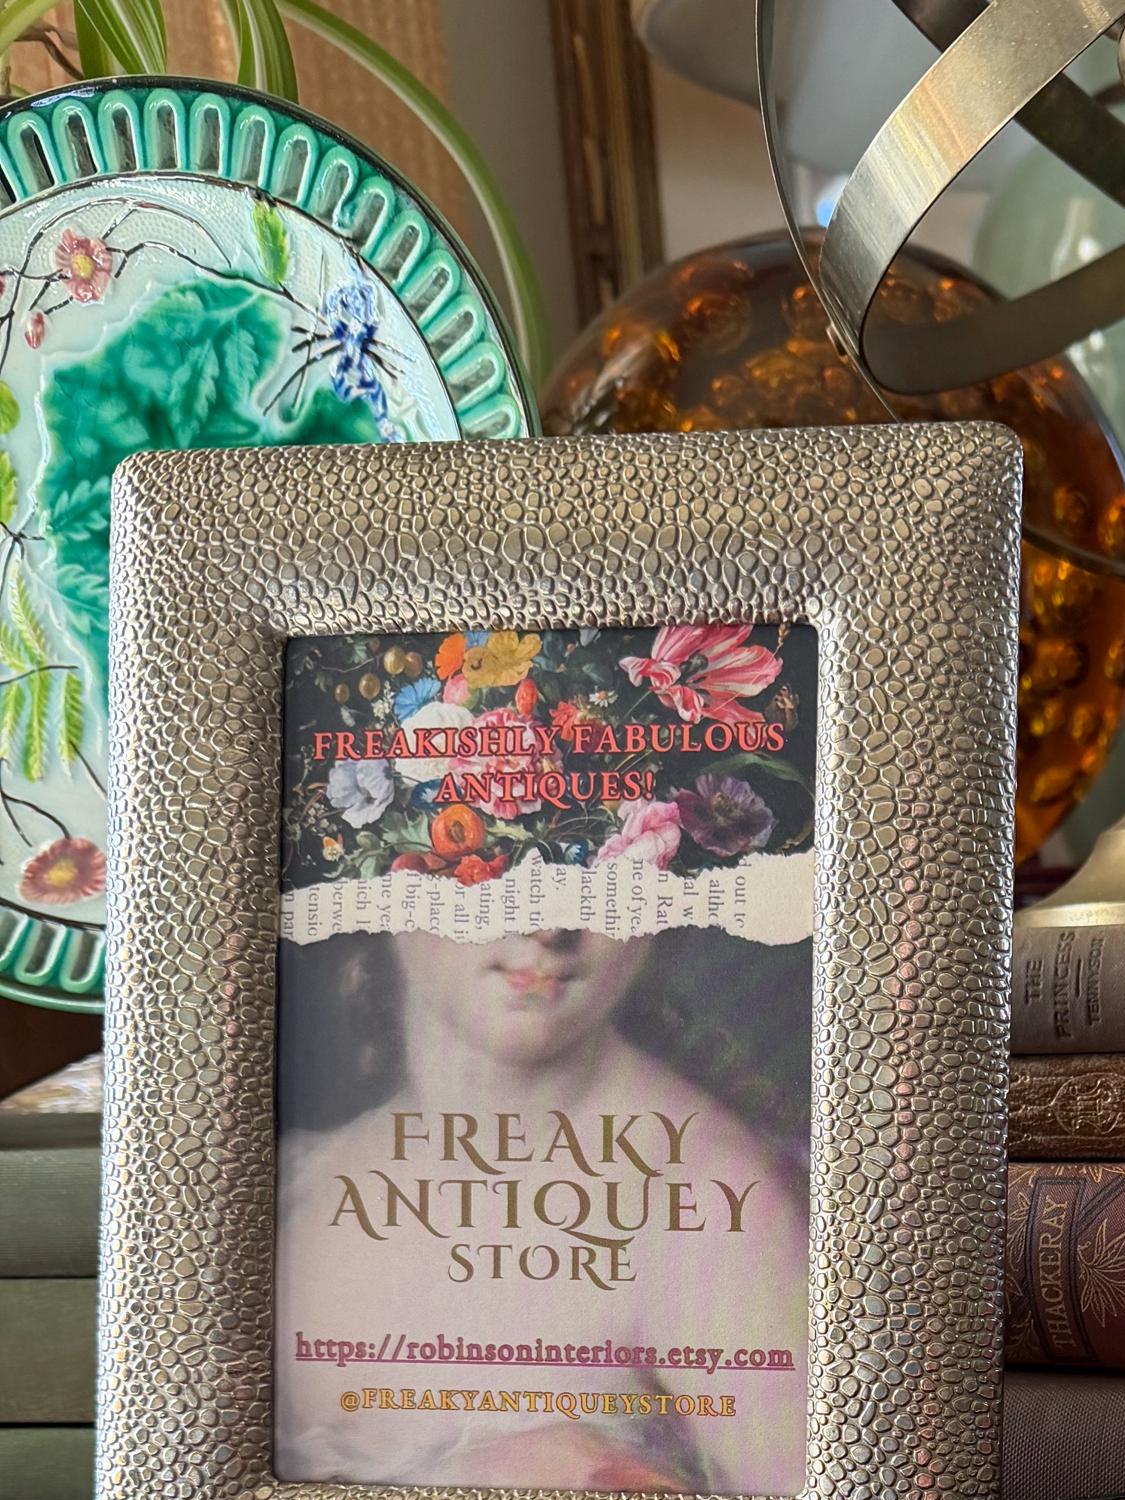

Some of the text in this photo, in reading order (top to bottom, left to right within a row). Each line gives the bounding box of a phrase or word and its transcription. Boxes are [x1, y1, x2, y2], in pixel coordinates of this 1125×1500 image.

[313, 721, 785, 761] FREAKISHLY FABULOUS
[435, 771, 656, 809] ANTIQUES!
[500, 878, 520, 922] night
[528, 854, 546, 905] watch
[631, 885, 647, 906] of
[734, 875, 747, 904] out
[454, 903, 470, 923] all
[1025, 960, 1043, 1005] THE
[1054, 930, 1075, 1039] PRINCESS
[1087, 938, 1104, 1026] TENNYSON
[390, 1109, 700, 1178] FREAKY
[328, 1170, 761, 1247] ANTIQUEY
[447, 1243, 638, 1291] STORE
[1040, 1195, 1077, 1349] THACKERAY
[295, 1332, 796, 1373] https://robinsoninteriors.etsy.com
[340, 1388, 737, 1419] @FREAKYANTIQUEYSTORE
